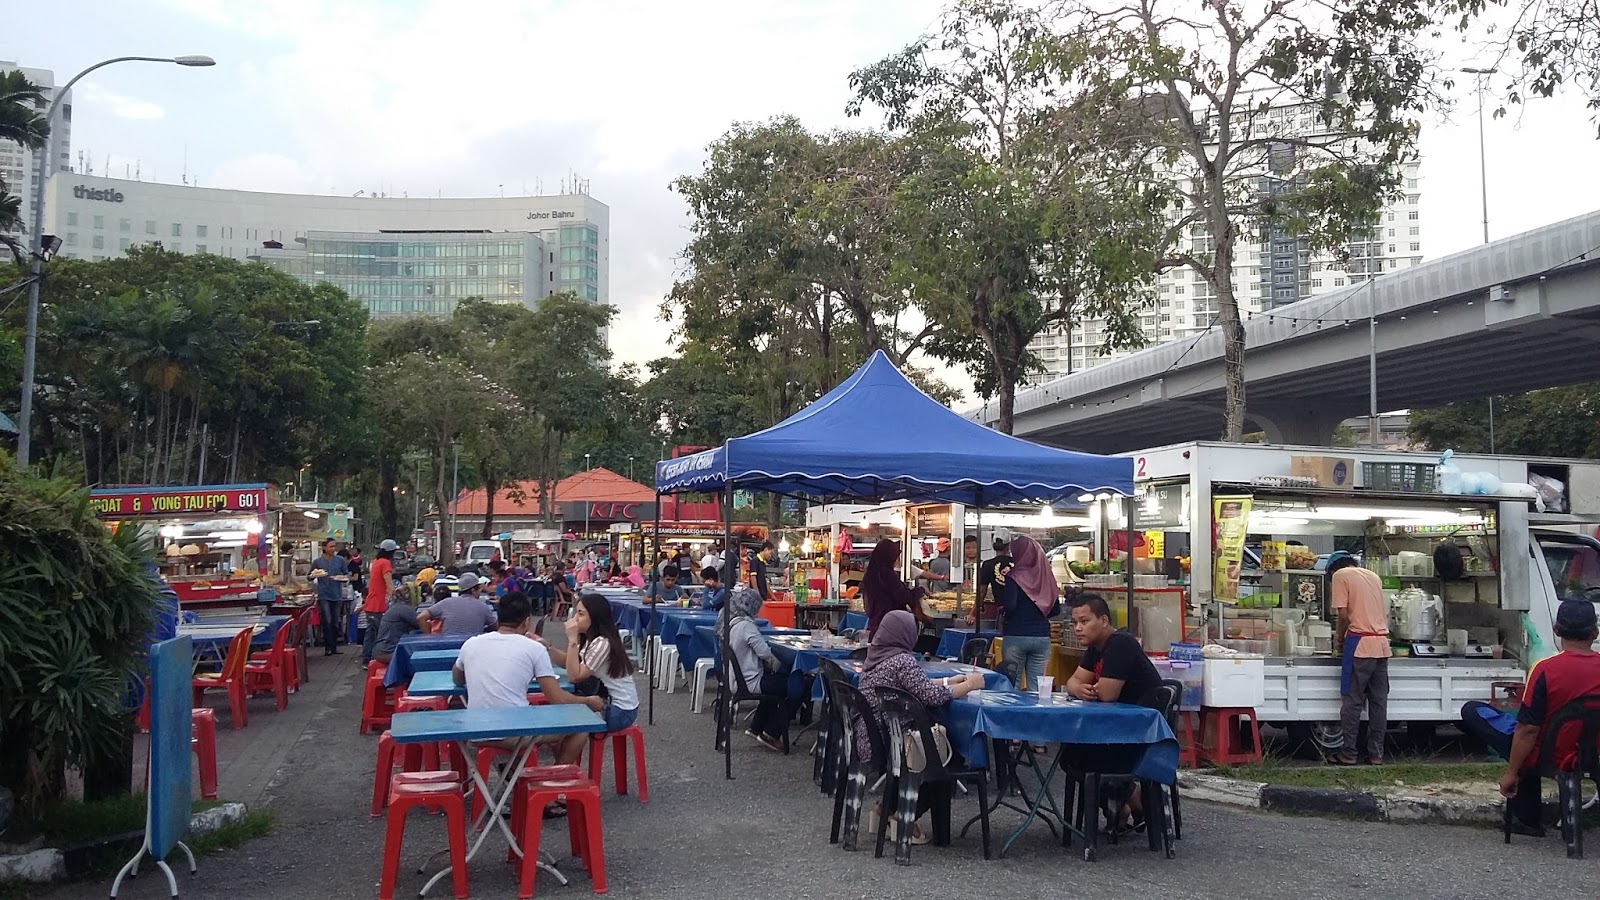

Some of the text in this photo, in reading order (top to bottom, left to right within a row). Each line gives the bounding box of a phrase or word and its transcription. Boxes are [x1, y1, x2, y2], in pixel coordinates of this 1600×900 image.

[73, 184, 124, 203] thistle
[526, 210, 575, 220] Johor Bahru
[133, 498, 141, 511] &
[152, 496, 181, 510] YONG
[183, 495, 204, 509] TAU
[590, 502, 640, 519] KFC
